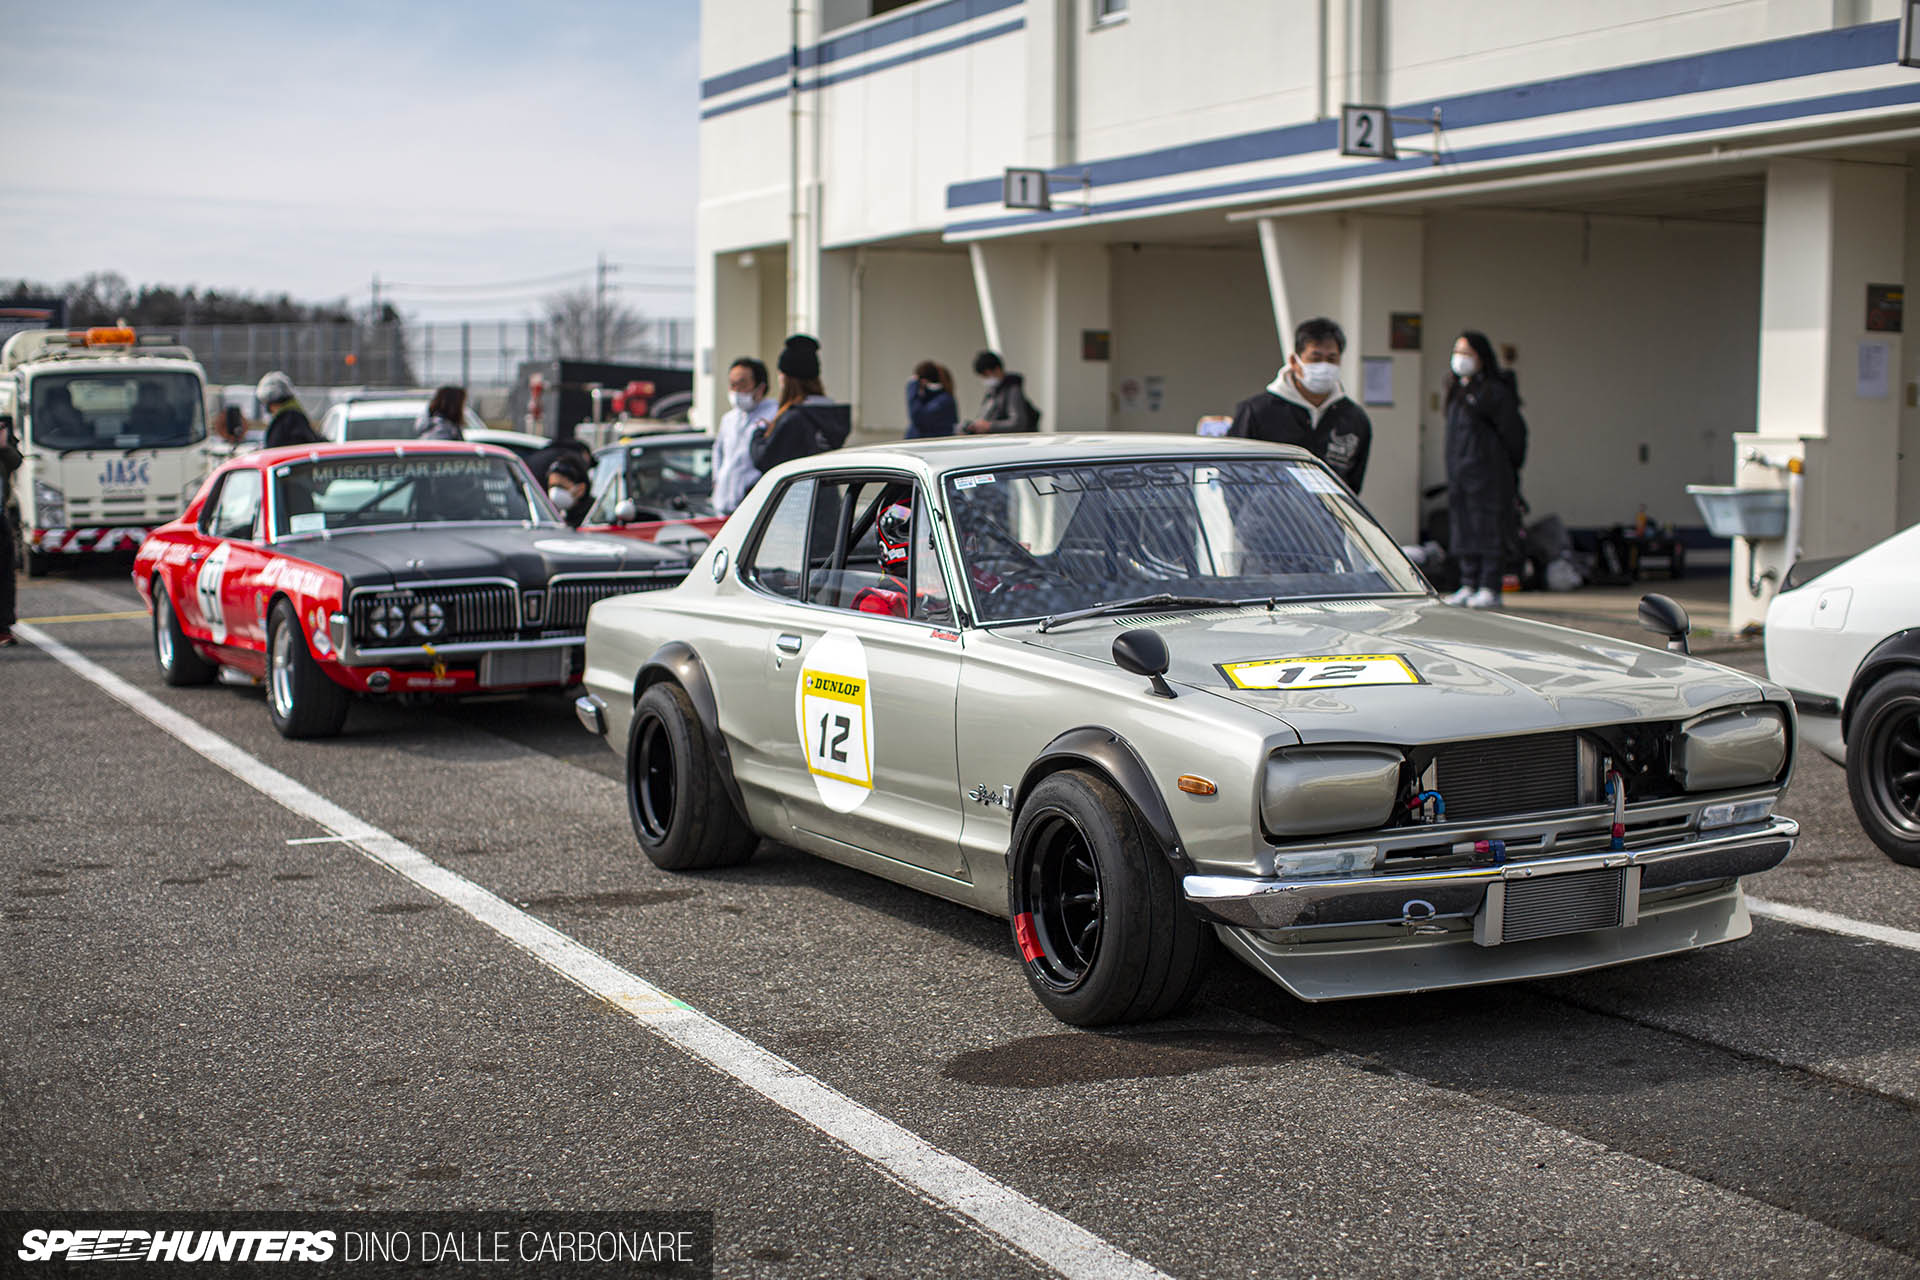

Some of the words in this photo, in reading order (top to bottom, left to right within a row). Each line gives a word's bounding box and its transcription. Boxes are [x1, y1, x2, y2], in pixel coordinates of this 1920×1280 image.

[1356, 113, 1372, 149] 2
[1020, 175, 1028, 204] 1
[432, 459, 491, 477] JAPAN
[1028, 463, 1288, 496] NISSAN
[814, 678, 860, 697] DUNLOP
[1277, 665, 1367, 684] 12
[819, 713, 850, 763] 12
